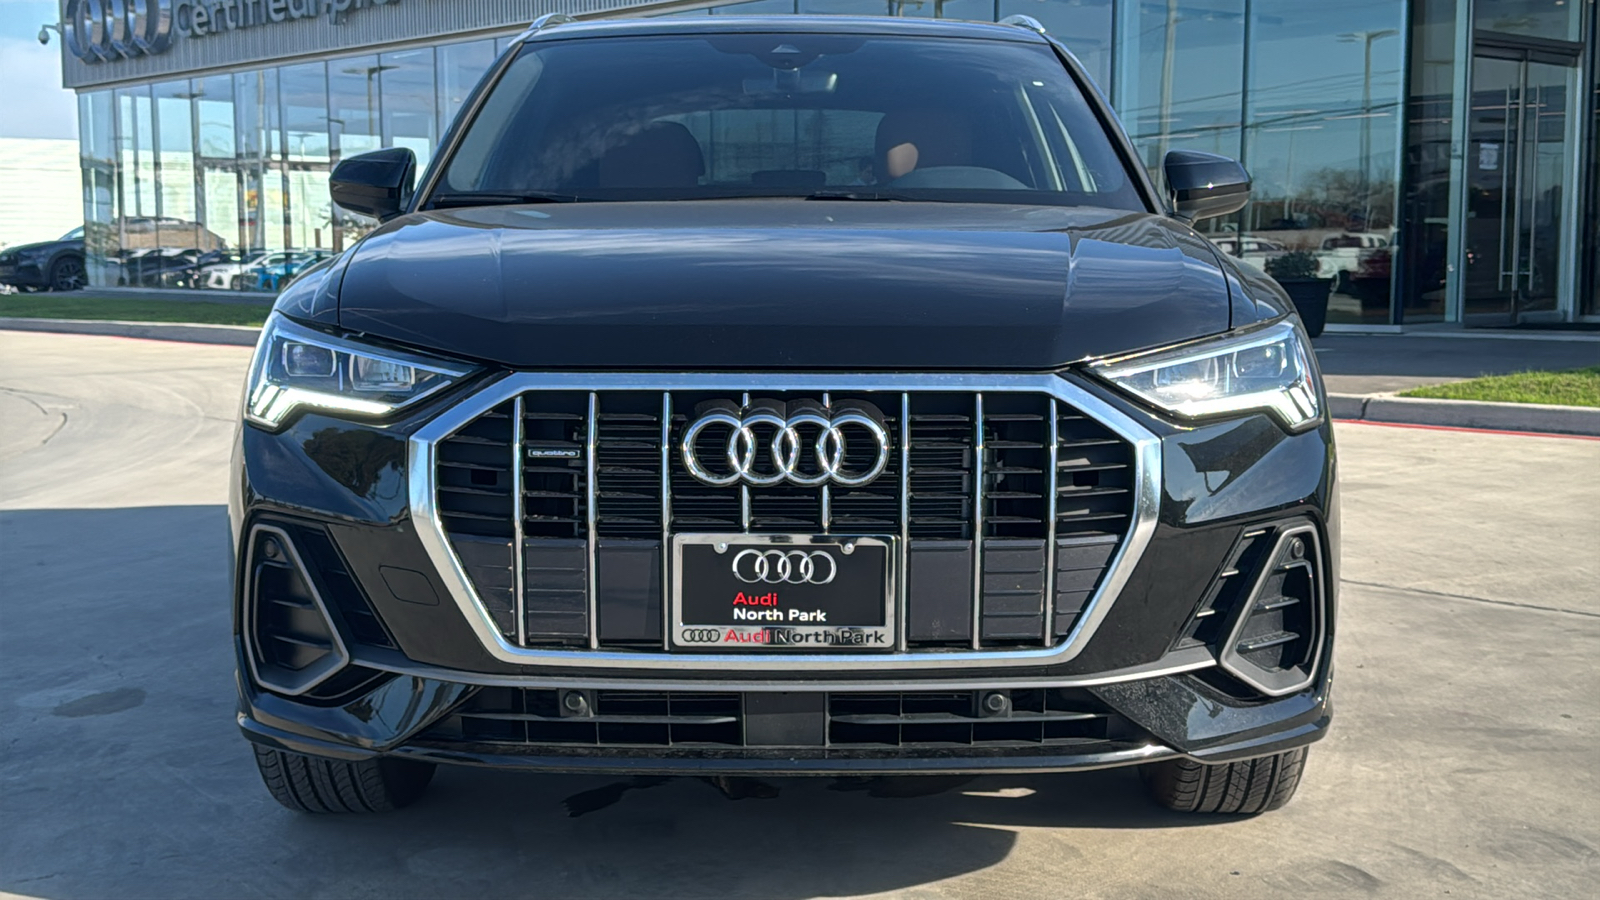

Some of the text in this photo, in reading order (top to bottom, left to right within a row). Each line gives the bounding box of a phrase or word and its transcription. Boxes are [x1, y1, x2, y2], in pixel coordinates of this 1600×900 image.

[733, 592, 778, 606] Audi
[733, 608, 826, 622] North Park
[724, 629, 885, 644] Audi North Park
